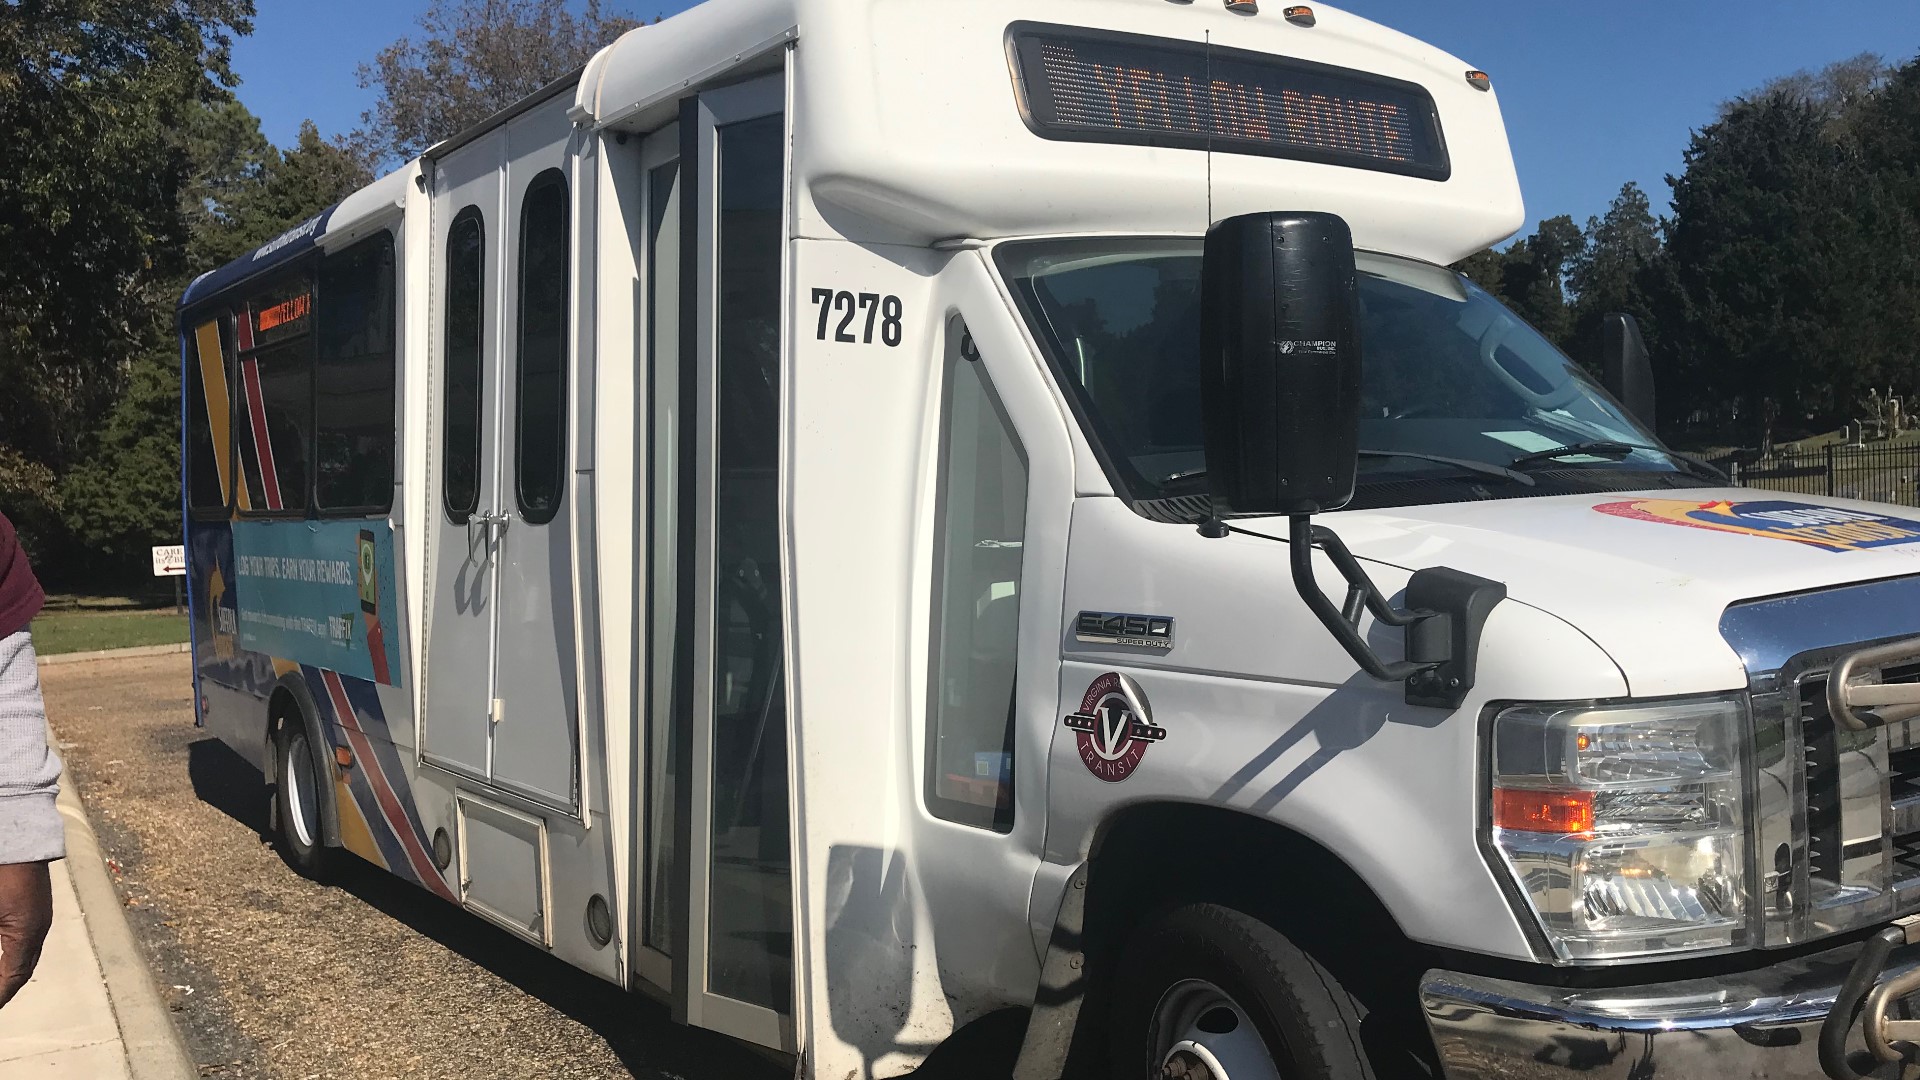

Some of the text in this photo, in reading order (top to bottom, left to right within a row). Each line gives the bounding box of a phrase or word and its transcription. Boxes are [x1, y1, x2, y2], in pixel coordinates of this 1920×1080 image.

[811, 287, 903, 348] 7278
[237, 555, 250, 576] LOG
[250, 555, 264, 577] YOUR
[281, 557, 298, 580] EARN
[298, 558, 317, 582] YOUR
[316, 559, 354, 586] REWARDS.
[1116, 637, 1170, 649] SUPER DUTY
[1082, 678, 1112, 711] VIRGINIA
[1080, 740, 1140, 776] TRANSIT
